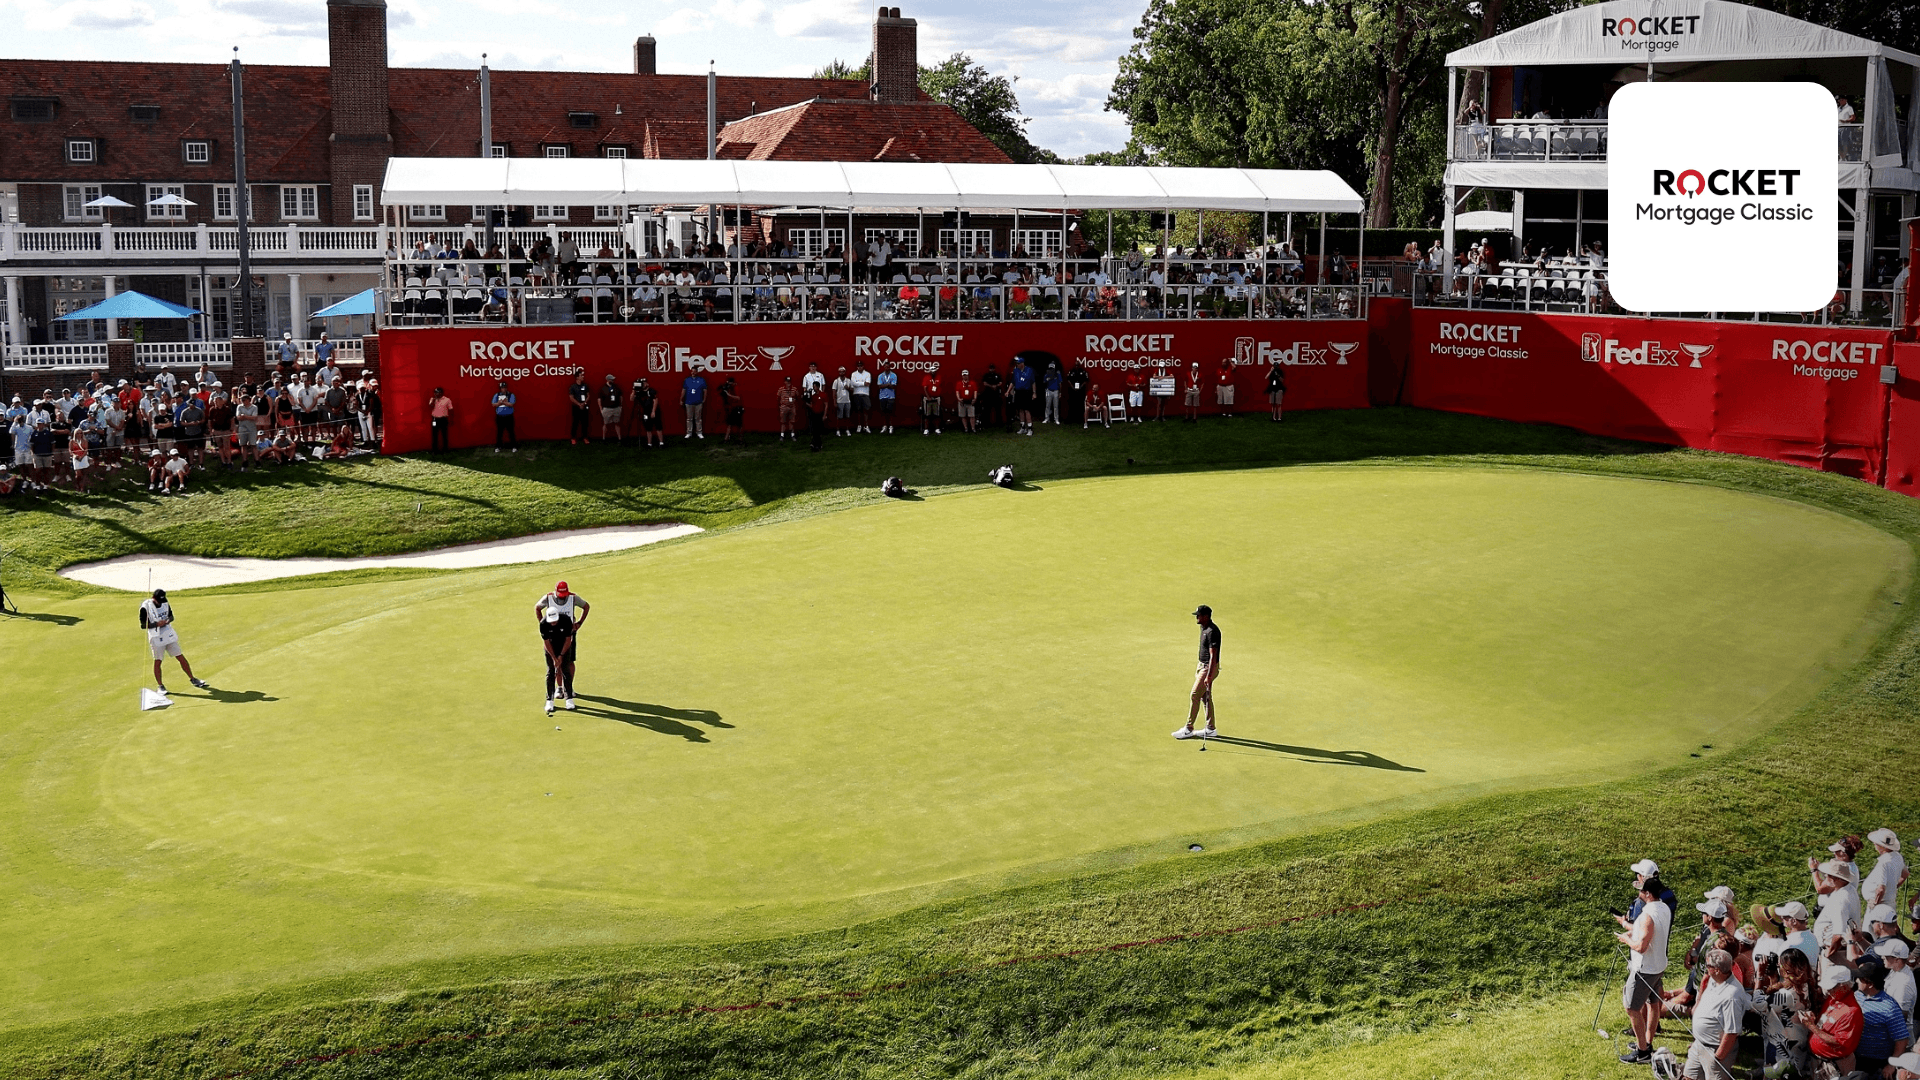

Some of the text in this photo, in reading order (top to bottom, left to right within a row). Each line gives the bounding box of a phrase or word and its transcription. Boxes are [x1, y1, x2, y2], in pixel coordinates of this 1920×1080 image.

[1603, 16, 1700, 37] ROCKET
[1621, 39, 1679, 52] Mortgage
[1439, 322, 1522, 344] ROCKET
[470, 341, 575, 362] ROCKET
[856, 335, 964, 356] ROCKET
[1086, 334, 1175, 354] ROCKET
[1257, 341, 1327, 366] FedEx
[1430, 343, 1529, 359] Mortgage Classic
[1604, 338, 1679, 367] FedEx
[1773, 339, 1883, 364] ROCKET
[674, 346, 758, 373] FedEx
[876, 358, 940, 373] Mortgage
[1076, 355, 1181, 372] Mortgage Classic
[460, 365, 531, 381] Mortgage
[1793, 362, 1858, 381] Mortgage
